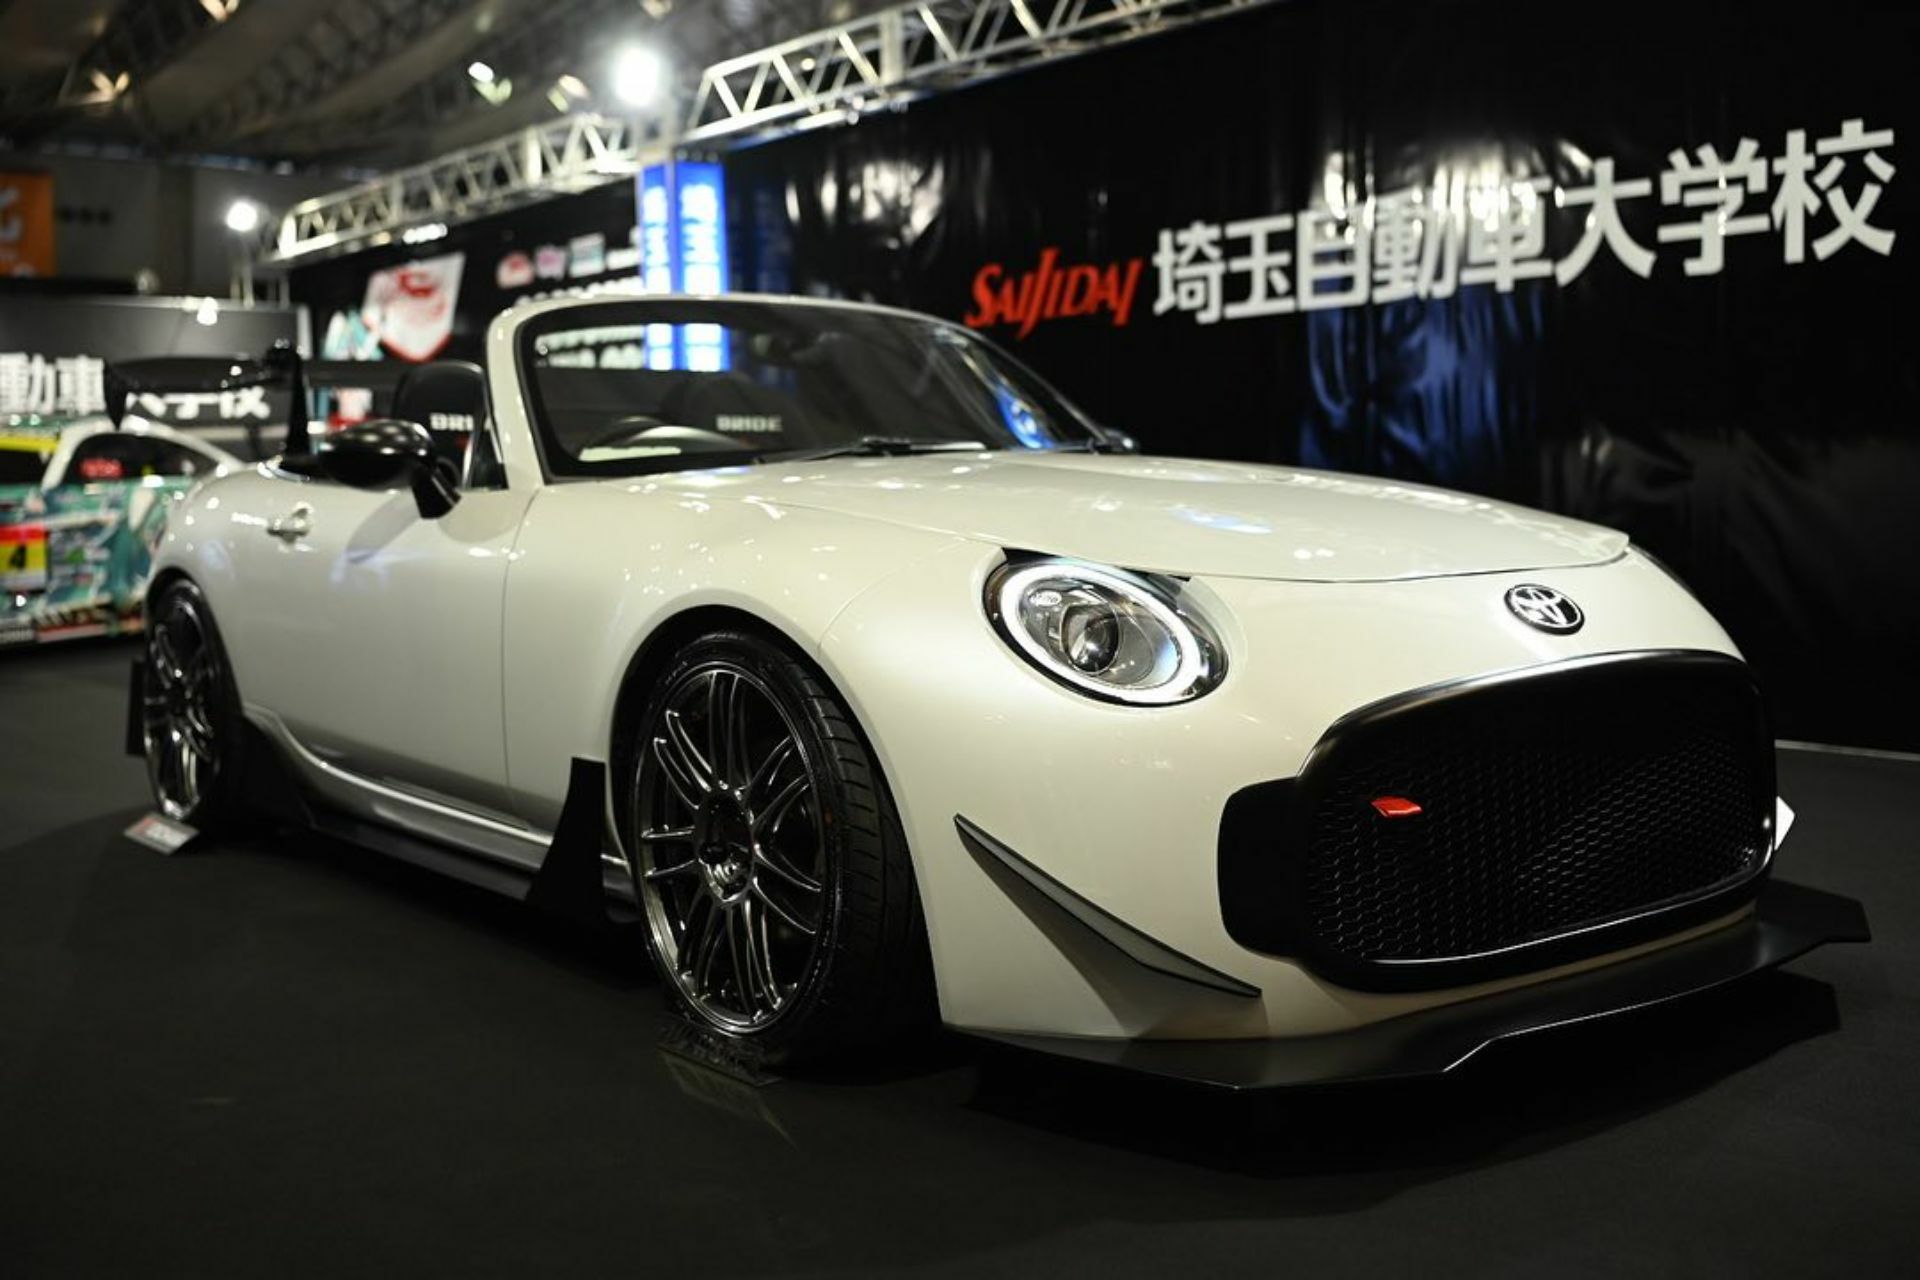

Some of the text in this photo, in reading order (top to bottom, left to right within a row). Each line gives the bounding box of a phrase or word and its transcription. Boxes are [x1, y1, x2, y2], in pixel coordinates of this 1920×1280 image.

[1152, 118, 1897, 325] 埼玉自動車大学校
[430, 412, 474, 431] BRI
[716, 414, 783, 432] BRIDE
